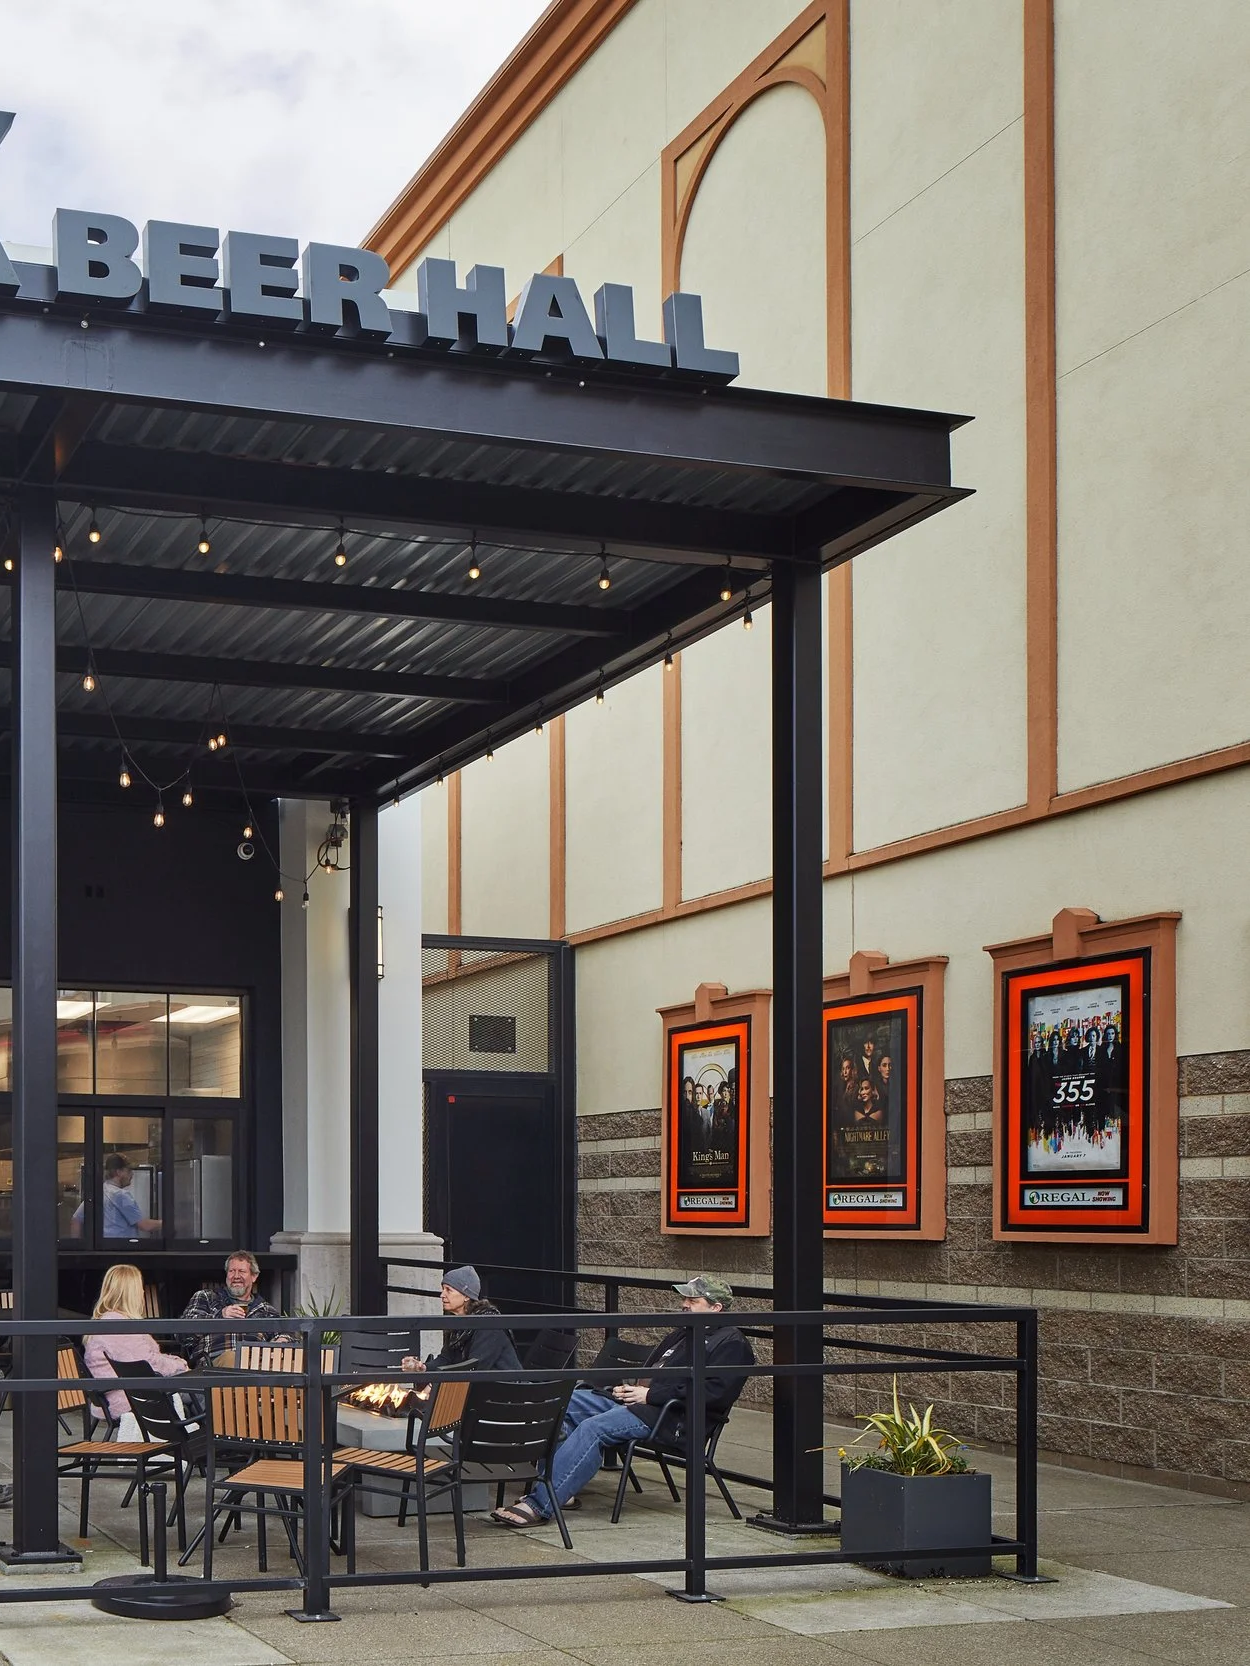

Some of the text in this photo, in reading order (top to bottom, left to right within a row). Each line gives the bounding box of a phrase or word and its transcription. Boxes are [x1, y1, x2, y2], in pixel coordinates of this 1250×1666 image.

[53, 207, 393, 342] BEER
[419, 257, 740, 386] HALL
[1052, 1079, 1096, 1103] 355
[844, 1130, 891, 1143] NIGHTMARE ALLEY
[714, 1150, 730, 1161] Man
[690, 1196, 719, 1205] REGAL
[841, 1194, 878, 1204] REGAL
[1041, 1192, 1090, 1203] REGAL
